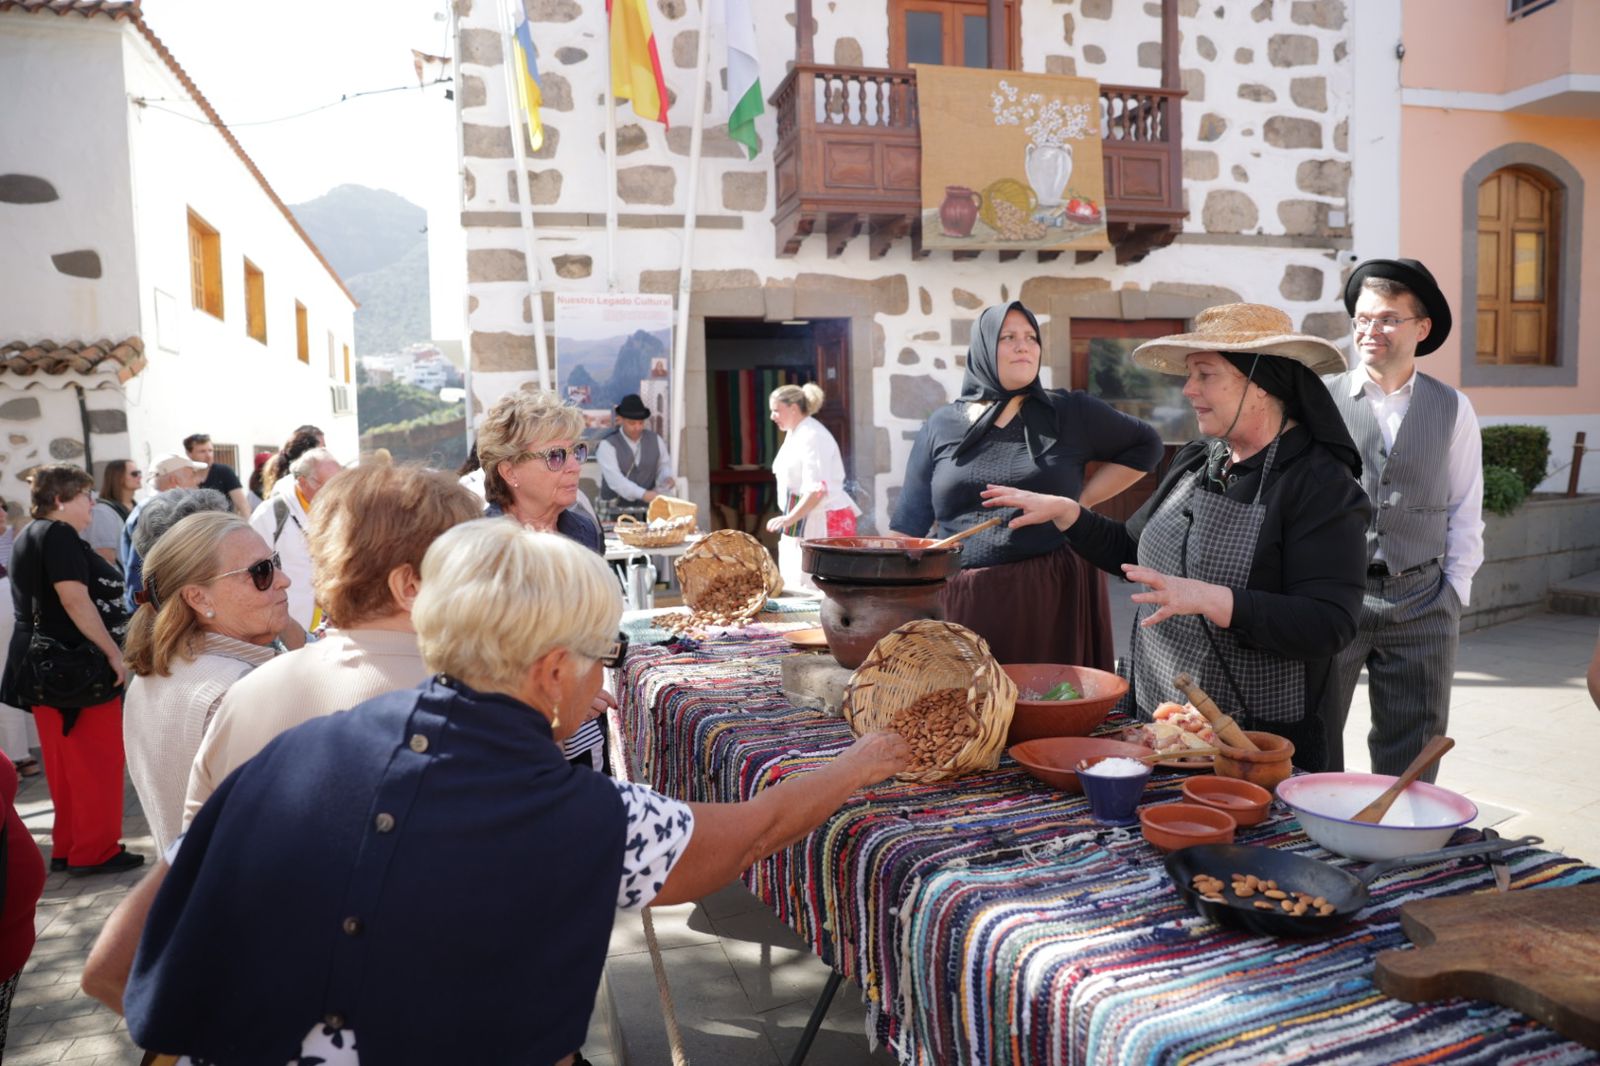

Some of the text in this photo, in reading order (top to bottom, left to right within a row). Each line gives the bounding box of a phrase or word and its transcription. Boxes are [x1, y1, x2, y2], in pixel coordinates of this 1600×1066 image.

[557, 296, 672, 307] Nuestro Legado Cultural
